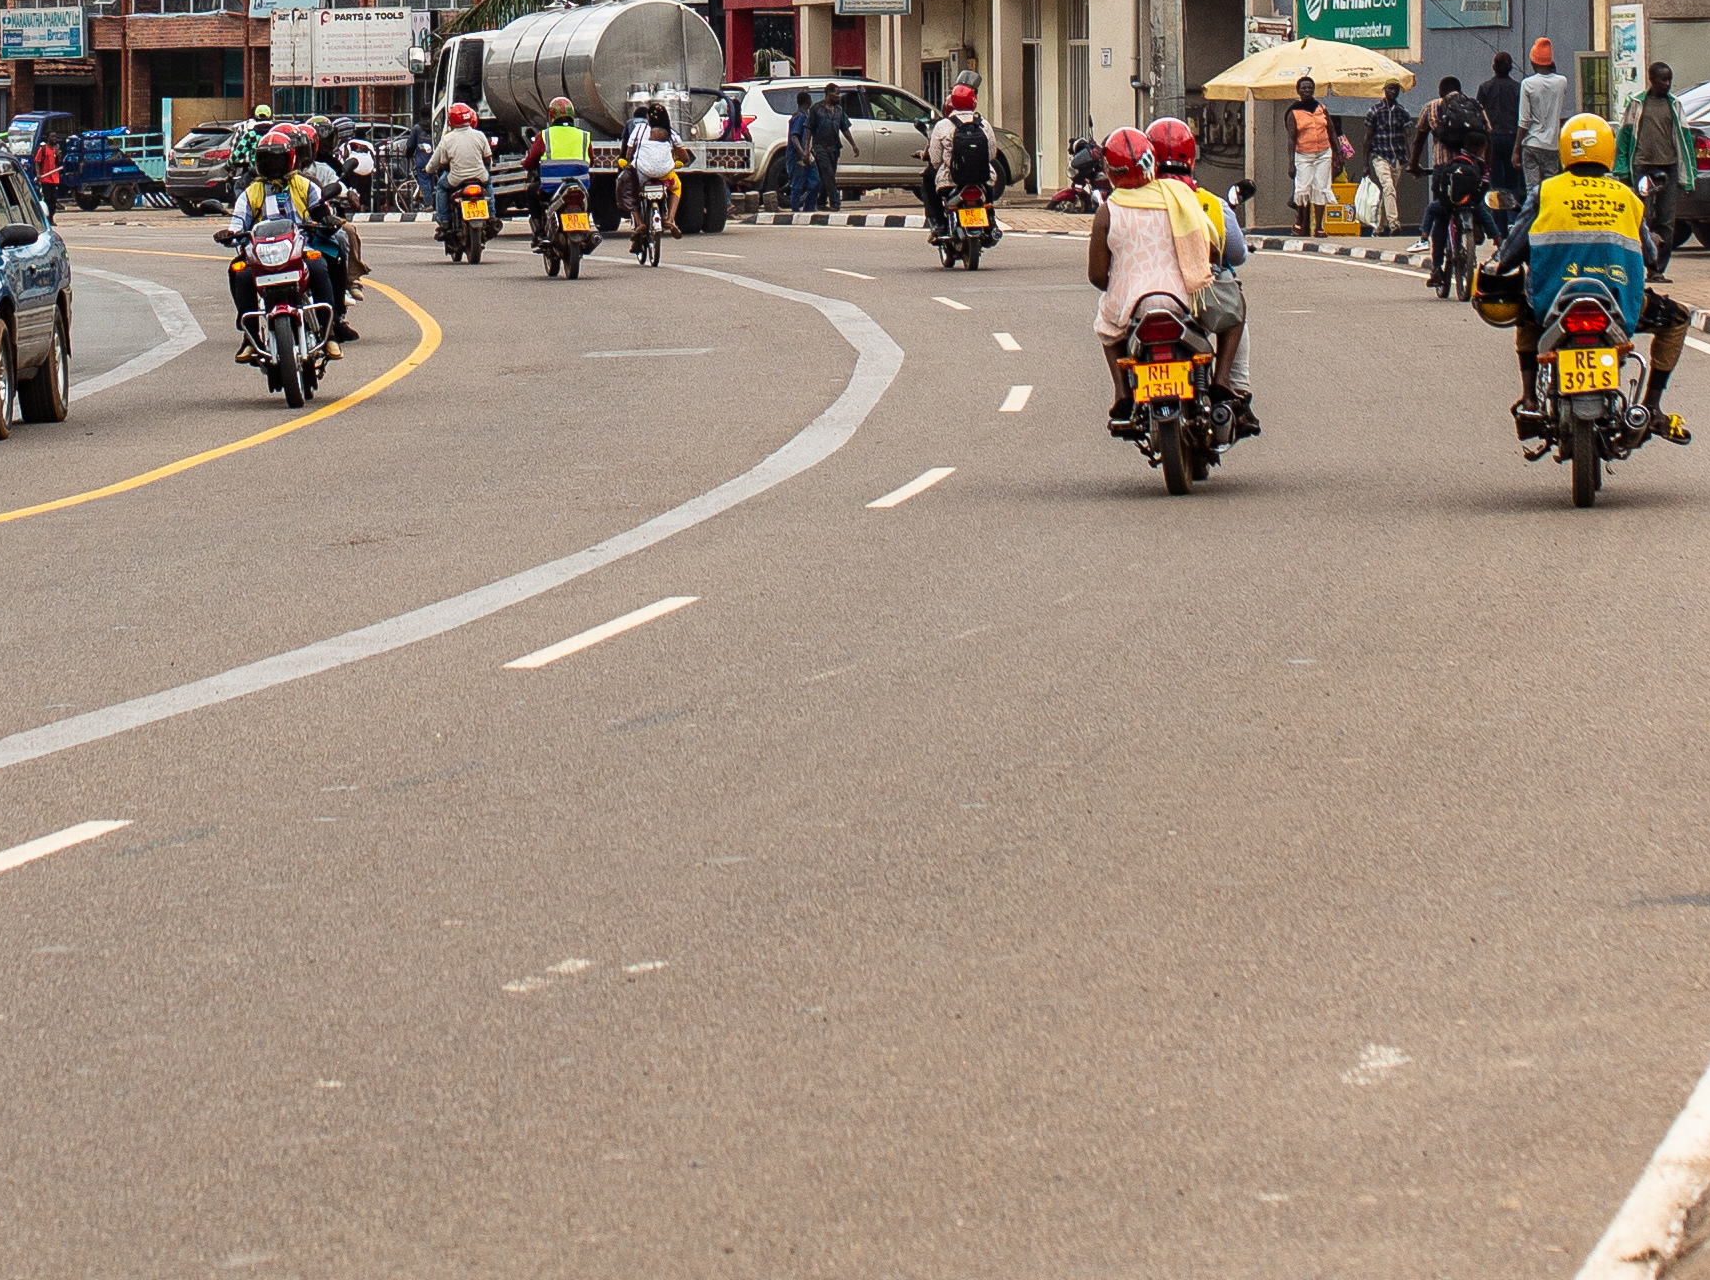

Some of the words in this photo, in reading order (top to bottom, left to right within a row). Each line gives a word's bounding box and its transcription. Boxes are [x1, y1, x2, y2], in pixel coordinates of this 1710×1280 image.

[11, 12, 42, 28] MARANATHA
[43, 10, 71, 27] PHARMACY
[334, 12, 363, 21] PARTS
[364, 12, 372, 21] &
[374, 11, 405, 20] TOOLS
[1333, 21, 1393, 42] www.premierbet.rw
[1575, 350, 1597, 370] RE
[1148, 364, 1170, 381] RH
